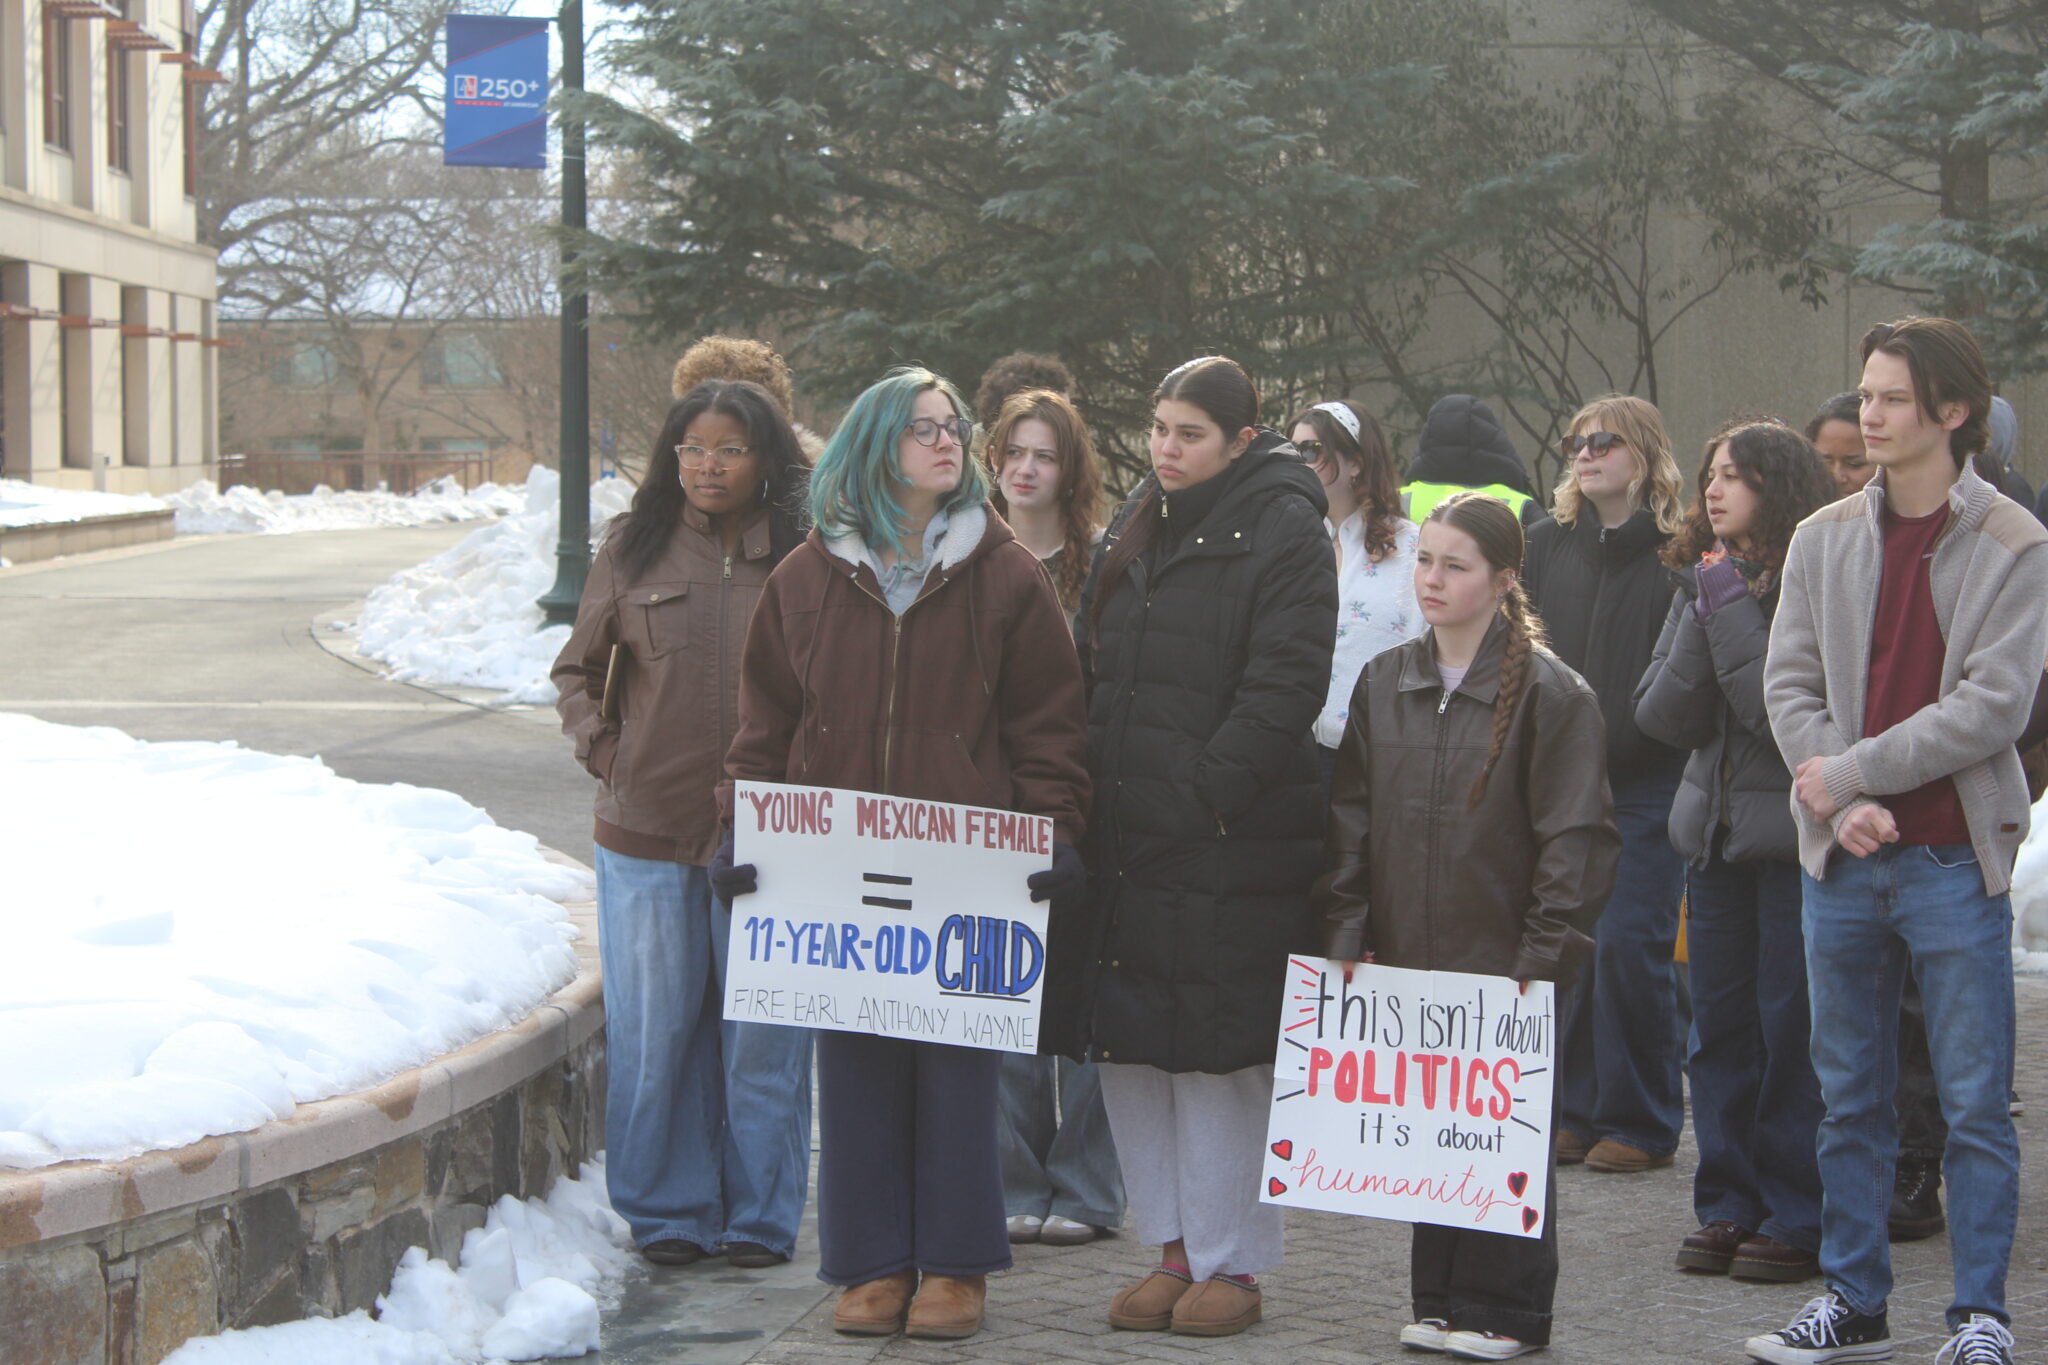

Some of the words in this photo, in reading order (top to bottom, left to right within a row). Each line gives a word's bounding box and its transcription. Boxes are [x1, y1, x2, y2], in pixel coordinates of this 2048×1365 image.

[480, 78, 540, 99] 250+
[856, 796, 956, 843] MEXICAN
[744, 916, 932, 975] 11-YEAR-OLD
[935, 914, 1045, 996] CHILD
[733, 989, 785, 1018] FIRE
[794, 992, 845, 1025] EARL
[857, 996, 950, 1035] ANTHONY
[963, 1011, 1035, 1049] WAYNE
[1304, 971, 1404, 1048] this
[1419, 988, 1485, 1053] isn't
[1495, 995, 1552, 1058] about
[1307, 1047, 1522, 1121] POLITICS
[1360, 1112, 1410, 1147] it's
[1437, 1122, 1506, 1153] about
[1290, 1148, 1522, 1223] humanity
